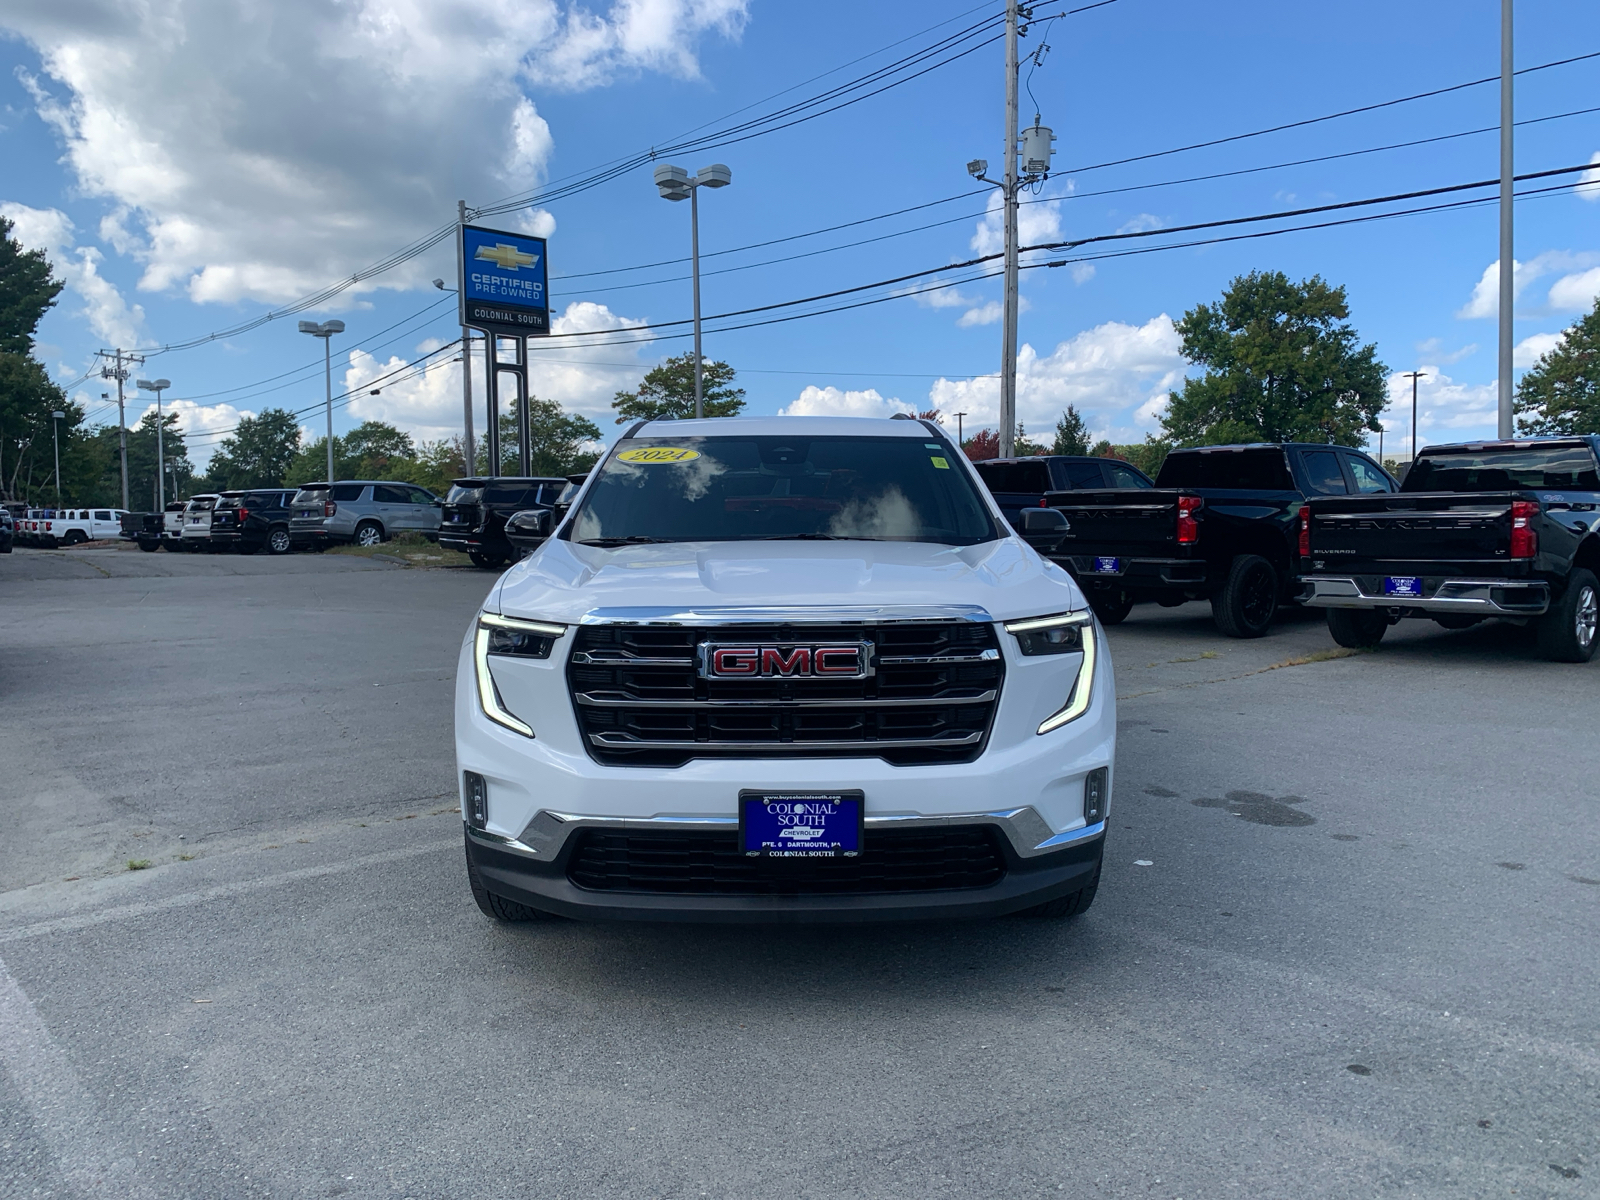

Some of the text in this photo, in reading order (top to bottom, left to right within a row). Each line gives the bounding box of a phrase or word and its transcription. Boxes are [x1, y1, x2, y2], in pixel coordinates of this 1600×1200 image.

[471, 273, 543, 291] CERTIFIED
[475, 283, 540, 299] PRE-OWNED
[474, 309, 542, 324] COLONIAL SOUTH
[628, 449, 689, 460] 2024
[713, 648, 860, 675] GMC
[767, 803, 837, 814] COLONIAL
[777, 815, 826, 825] SOUTH
